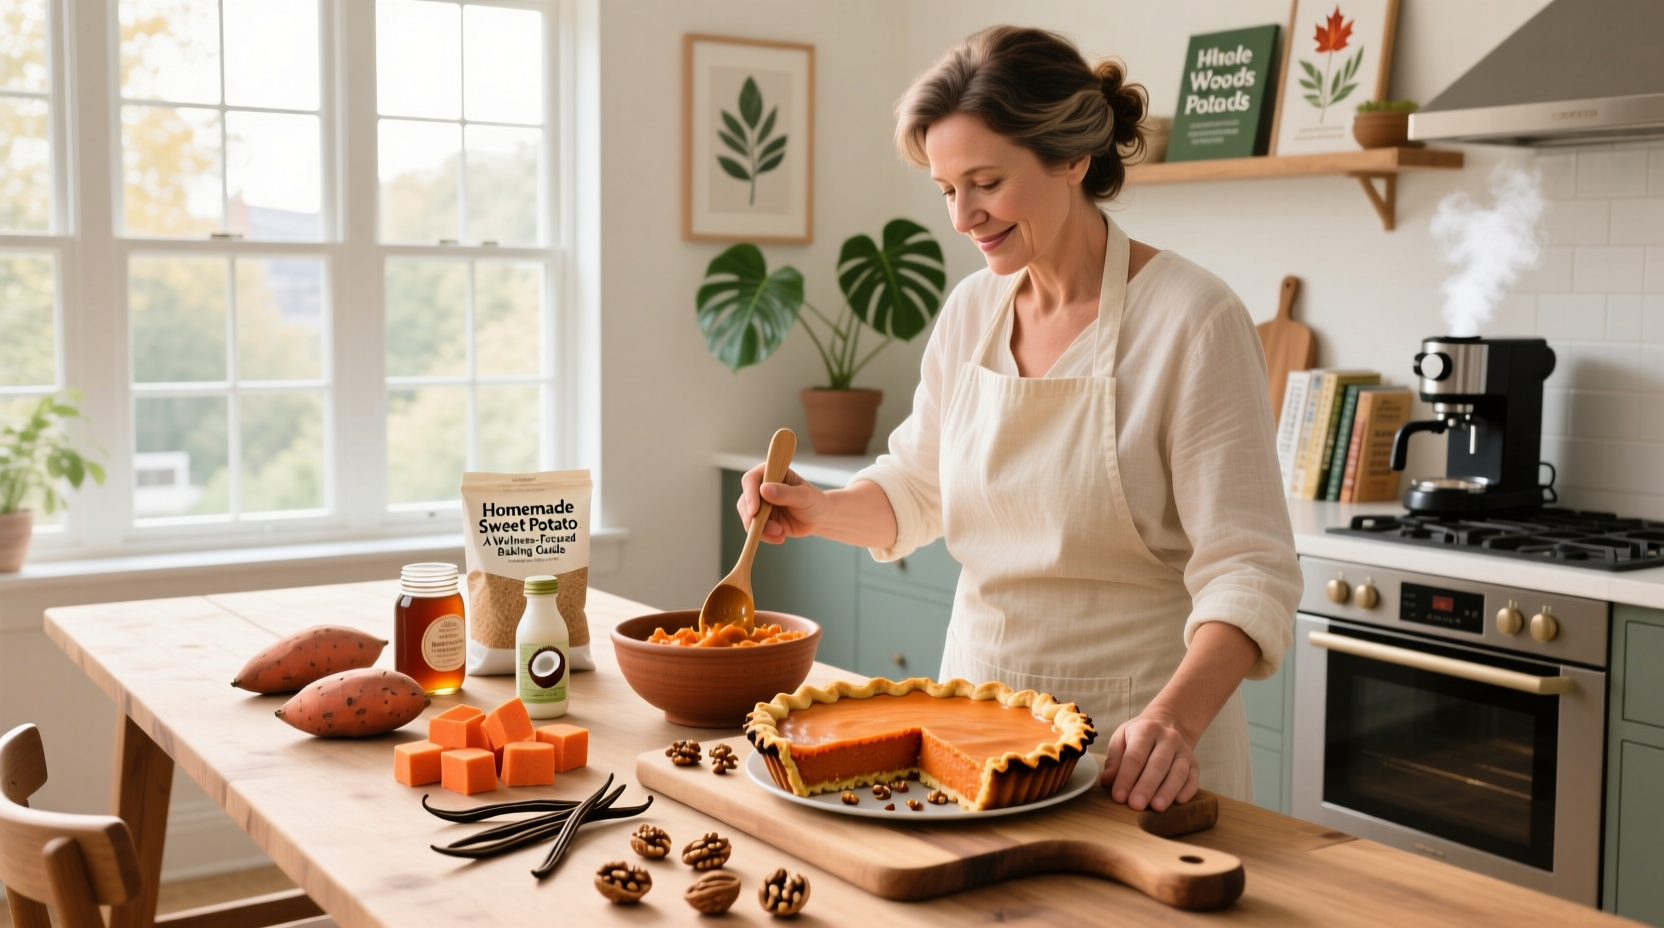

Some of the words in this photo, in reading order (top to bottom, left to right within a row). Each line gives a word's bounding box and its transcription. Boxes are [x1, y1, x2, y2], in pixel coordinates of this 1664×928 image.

[1190, 66, 1256, 92] Woods
[482, 499, 574, 517] Homemade
[479, 519, 526, 533] Sweet
[529, 518, 578, 531] Potato
